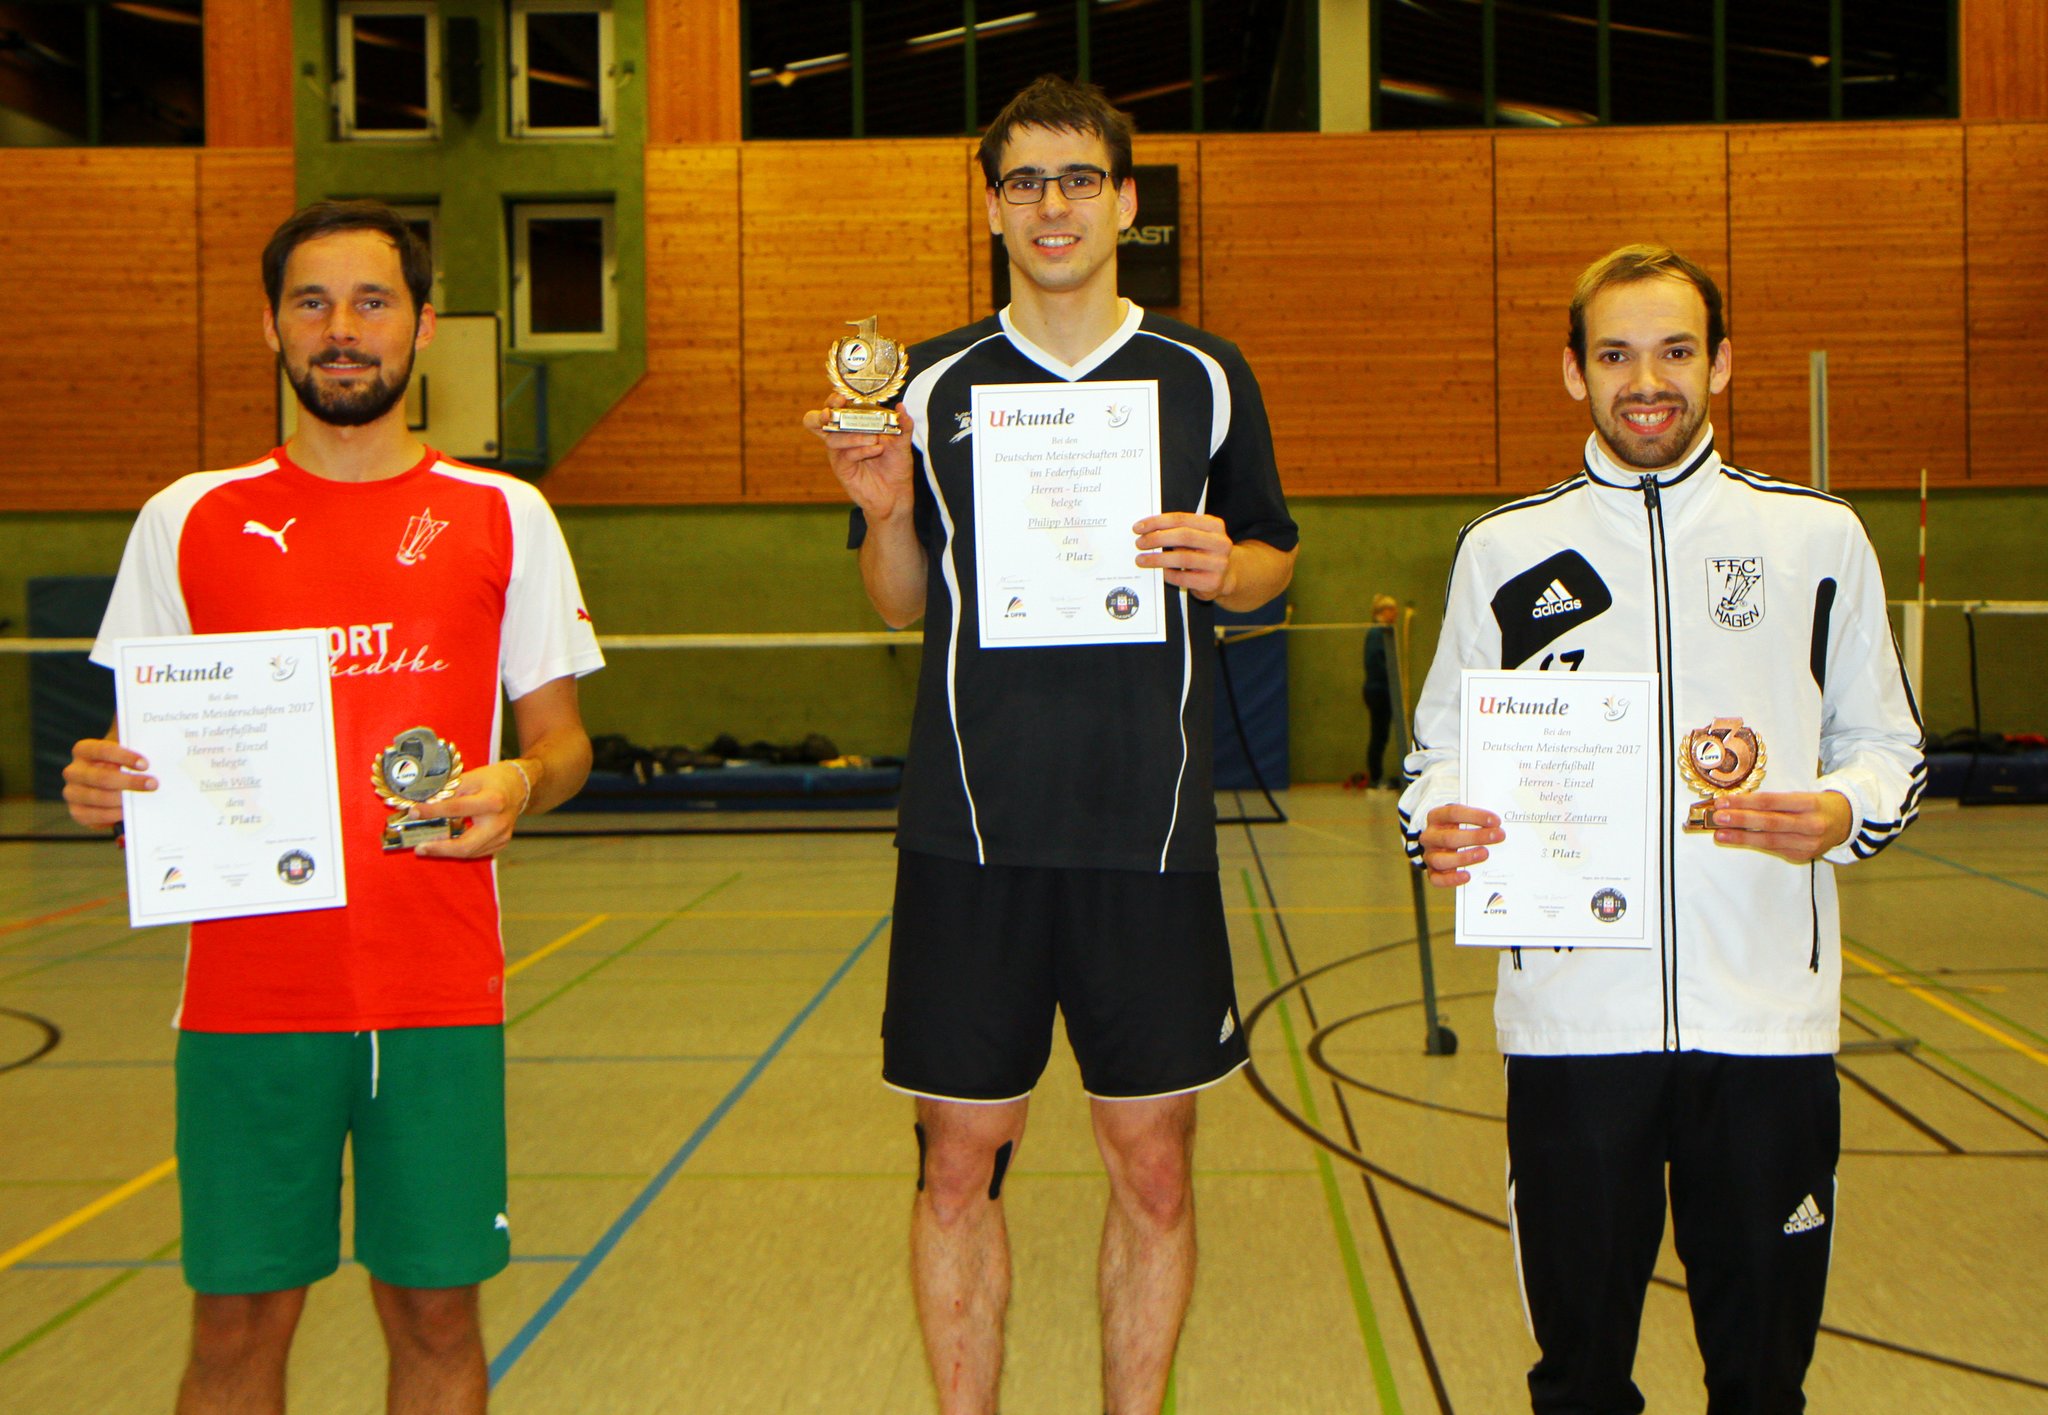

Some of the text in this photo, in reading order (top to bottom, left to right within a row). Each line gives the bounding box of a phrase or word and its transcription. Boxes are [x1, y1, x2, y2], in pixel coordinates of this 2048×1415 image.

[989, 408, 1075, 428] Urkunde
[1051, 436, 1078, 445] Bei den
[995, 448, 1144, 463] Deutschen Meisterschaften 2017
[1030, 466, 1102, 480] im Federfußball
[1031, 485, 1064, 495] Herren
[1073, 483, 1102, 493] Einzel
[1051, 498, 1083, 508] belegte
[1028, 517, 1107, 528] Philipp Münzner
[1062, 536, 1079, 545] den
[1066, 552, 1094, 562] Platz
[1712, 558, 1756, 573] FFC
[1532, 599, 1582, 619] adidas
[1715, 604, 1760, 627] HAGEN
[136, 661, 234, 684] Urkunde
[1479, 696, 1569, 716] Urkunde
[143, 702, 315, 723] Deutschen Meisterschaften 2017
[1543, 728, 1571, 736] Bei den
[187, 745, 225, 756] Herren
[235, 741, 269, 752] Einzel
[1482, 741, 1641, 756] Deutschen Meisterschaften 2017
[211, 757, 248, 770] belegte
[1519, 760, 1595, 773] im Federfußball
[1519, 777, 1554, 787] Herren
[1564, 778, 1594, 788] Einzel
[225, 798, 245, 808] den
[1539, 791, 1573, 803] belegte
[230, 815, 262, 825] Platz
[1504, 811, 1608, 823] Christopher Zentarra
[1549, 831, 1567, 841] den
[1552, 848, 1581, 859] Platz
[1783, 1213, 1825, 1234] adidas
